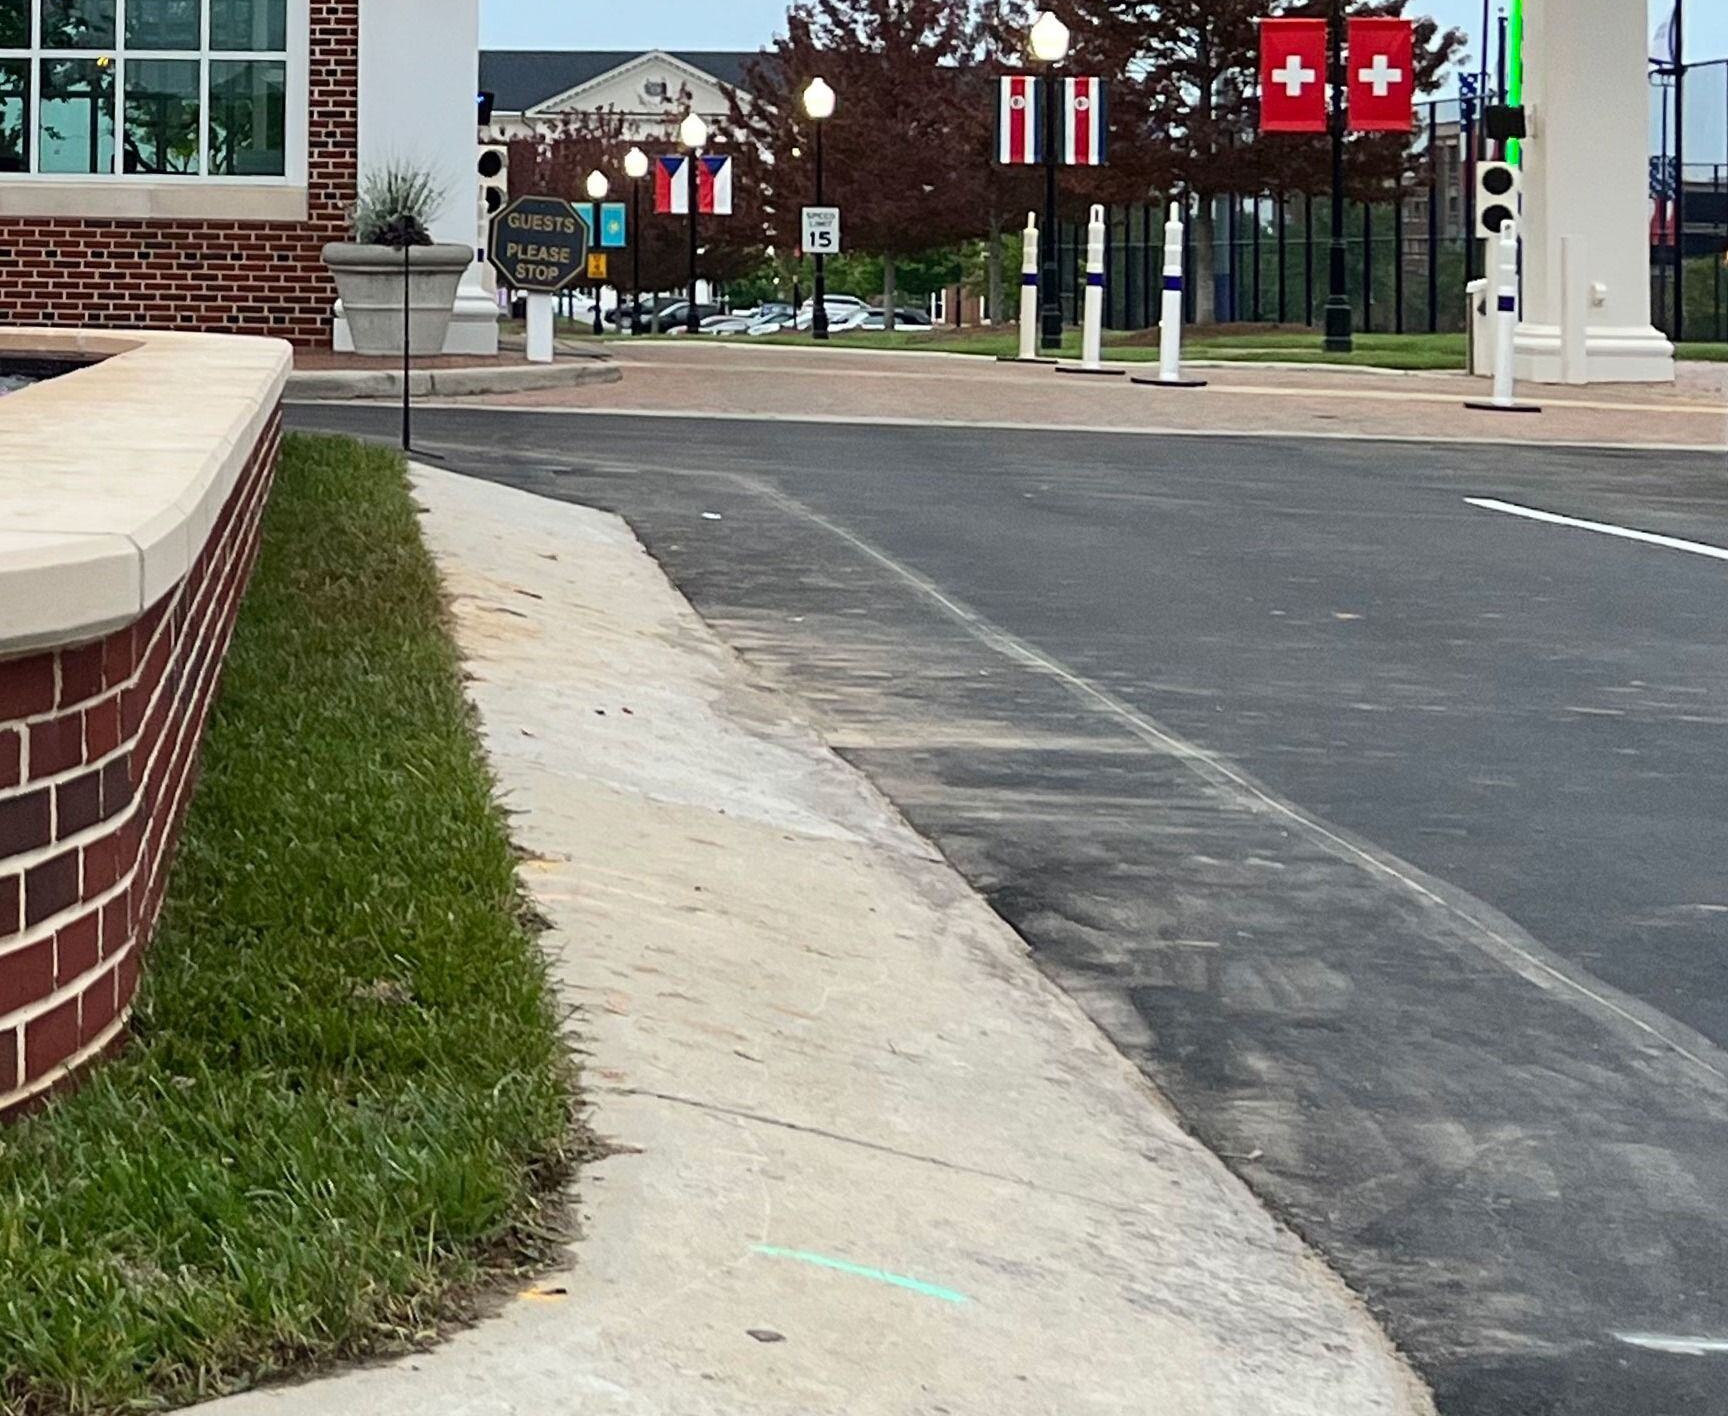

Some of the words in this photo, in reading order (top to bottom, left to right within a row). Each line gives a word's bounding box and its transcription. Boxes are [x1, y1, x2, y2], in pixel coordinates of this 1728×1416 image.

[507, 212, 575, 233] GUESTS
[809, 230, 832, 248] 15
[506, 242, 571, 263] PLEASE
[514, 263, 559, 280] STOP
